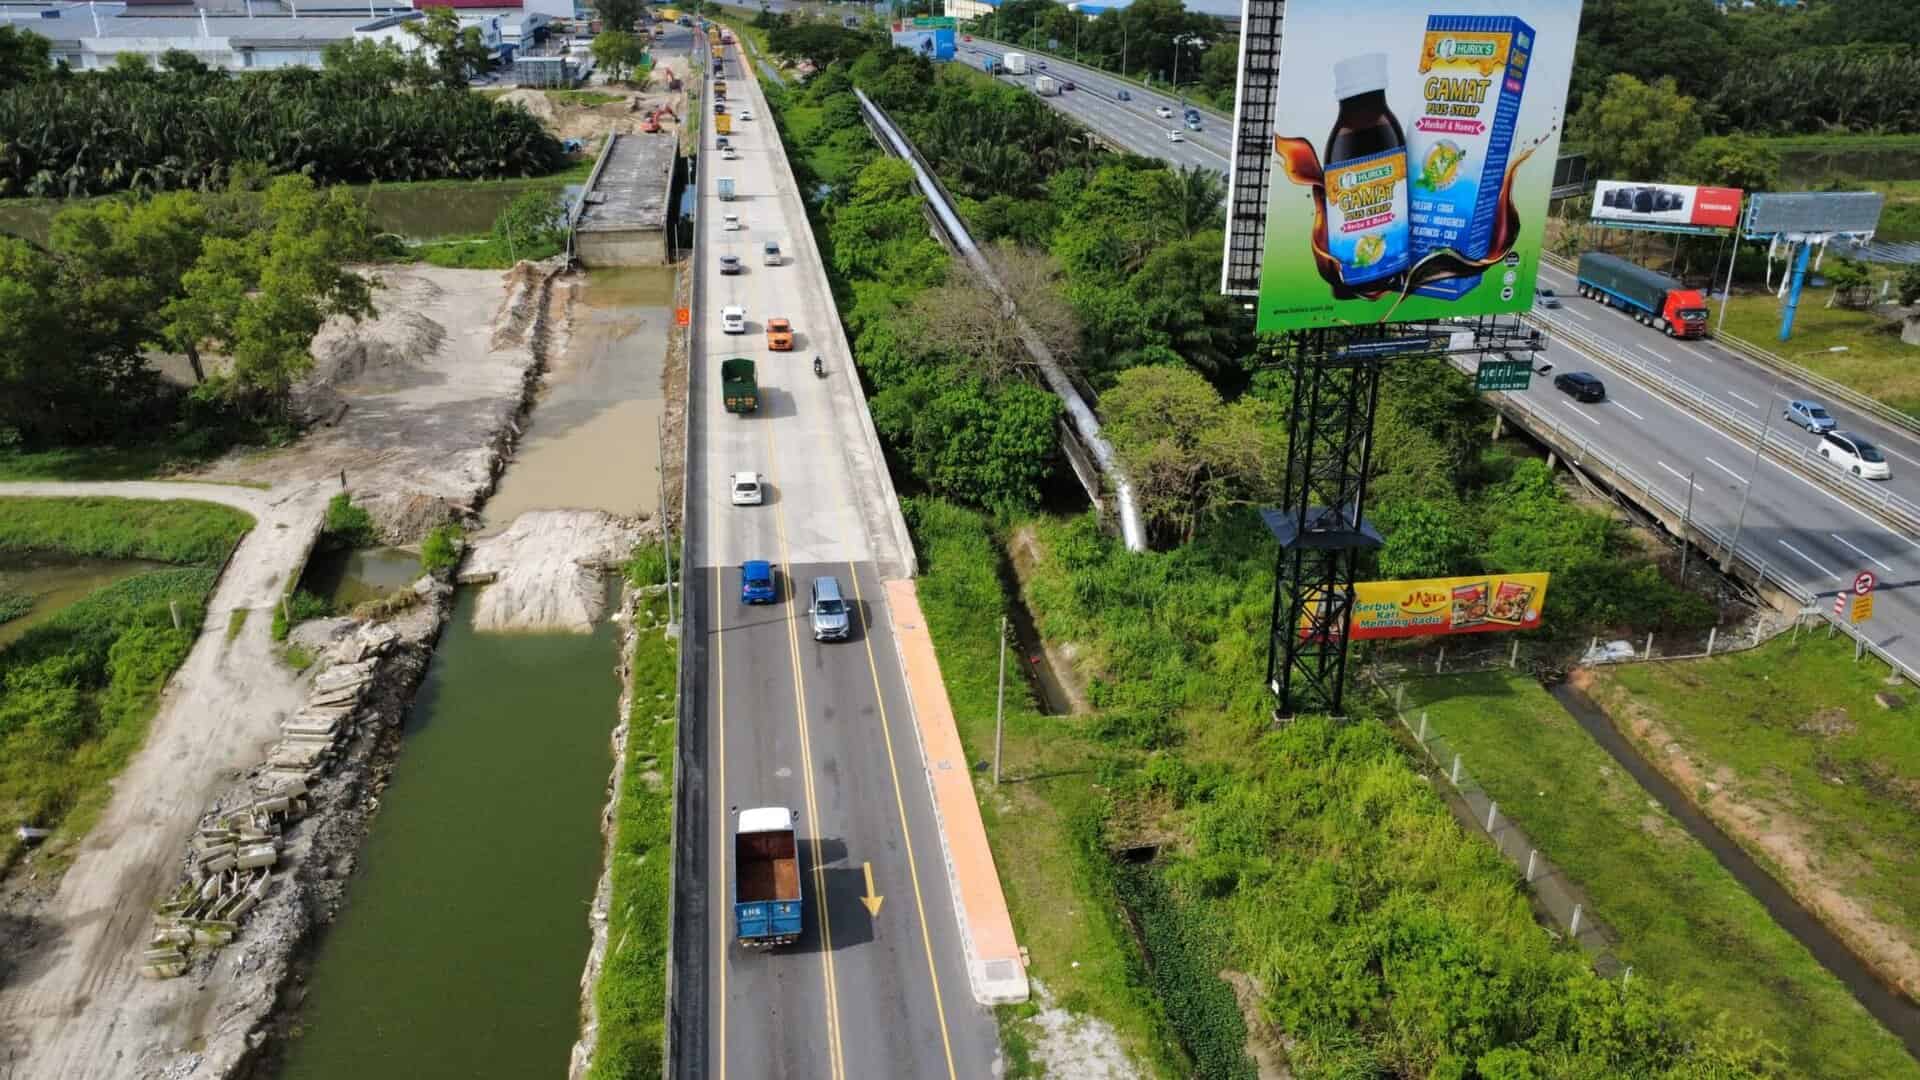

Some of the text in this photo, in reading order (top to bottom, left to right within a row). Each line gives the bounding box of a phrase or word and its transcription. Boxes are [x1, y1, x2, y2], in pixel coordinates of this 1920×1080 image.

[1424, 76, 1491, 103] GAMAT
[1425, 103, 1480, 117] PLUS SYRUP
[1338, 182, 1395, 211] GAMAT
[1354, 601, 1395, 612] Serbuk
[1360, 618, 1408, 628] Memang
